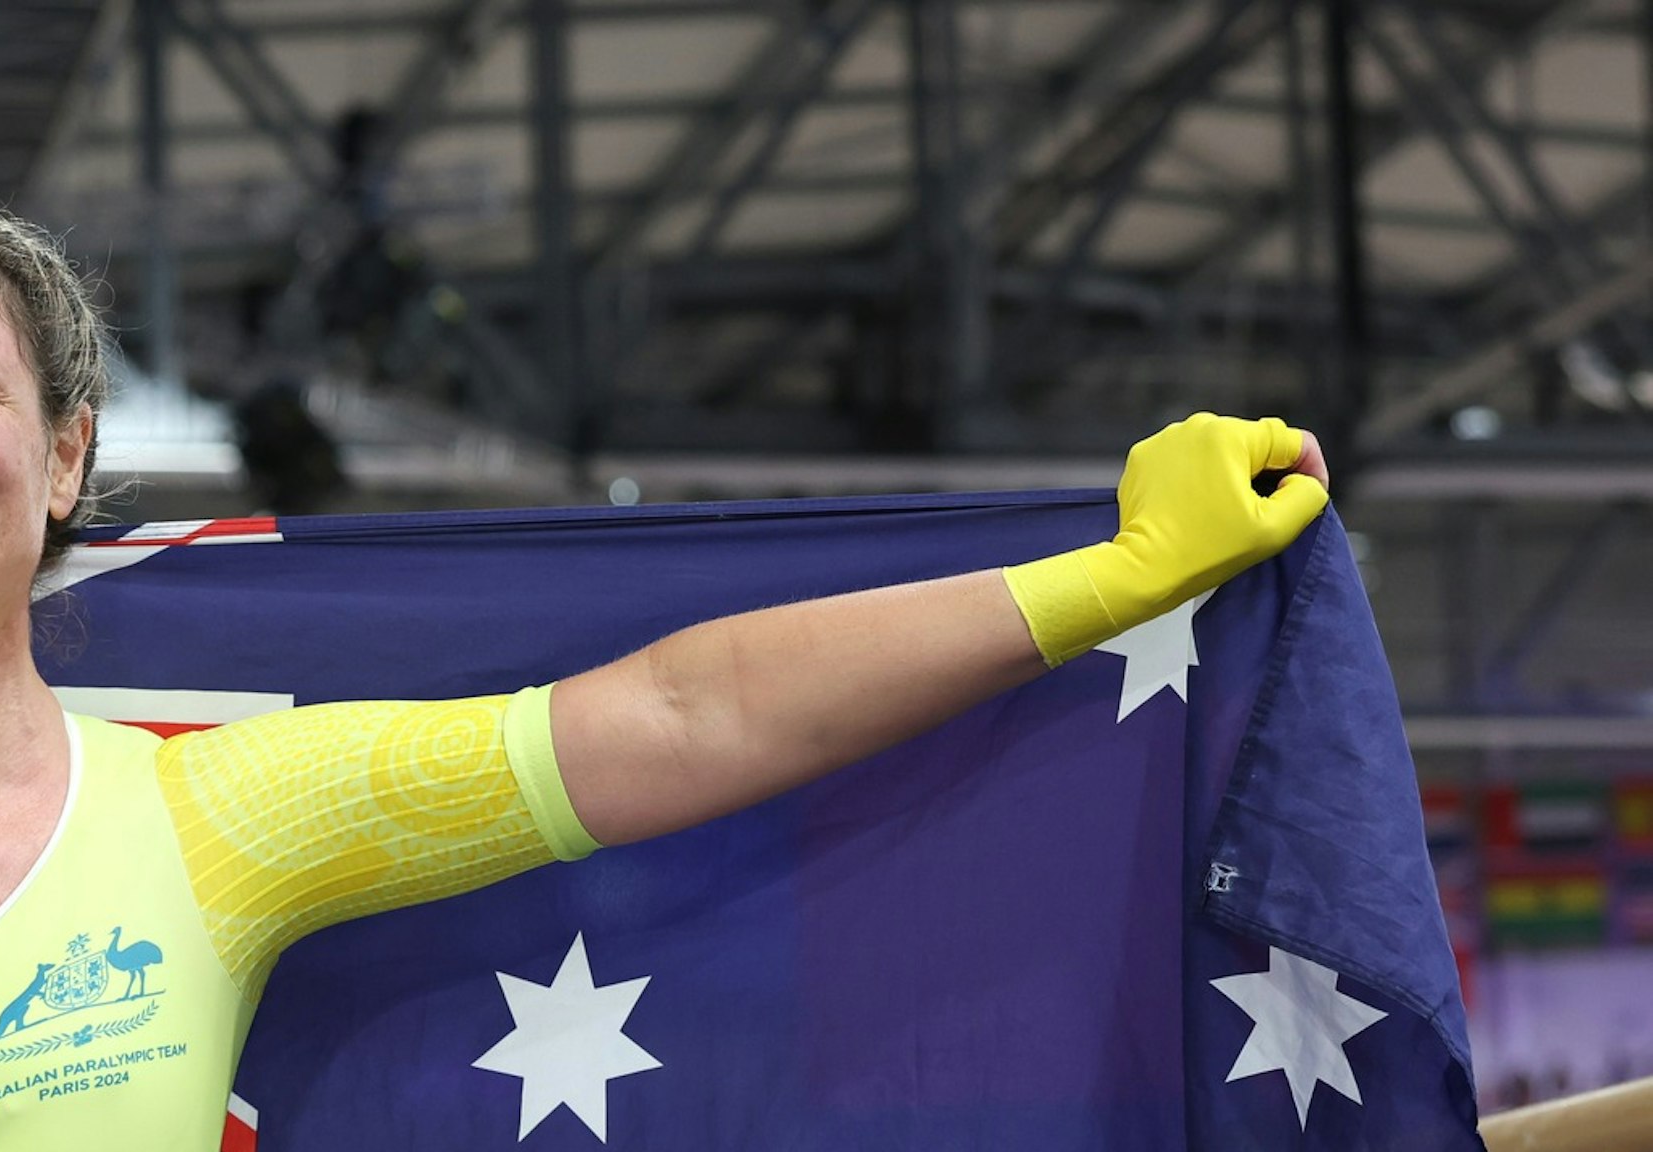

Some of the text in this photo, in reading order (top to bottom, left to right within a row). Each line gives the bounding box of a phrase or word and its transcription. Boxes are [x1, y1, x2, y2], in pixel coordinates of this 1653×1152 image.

[62, 1048, 155, 1078] PARALYMPIC
[158, 1042, 188, 1059] TEAM
[38, 1070, 130, 1101] PARIS 2024
